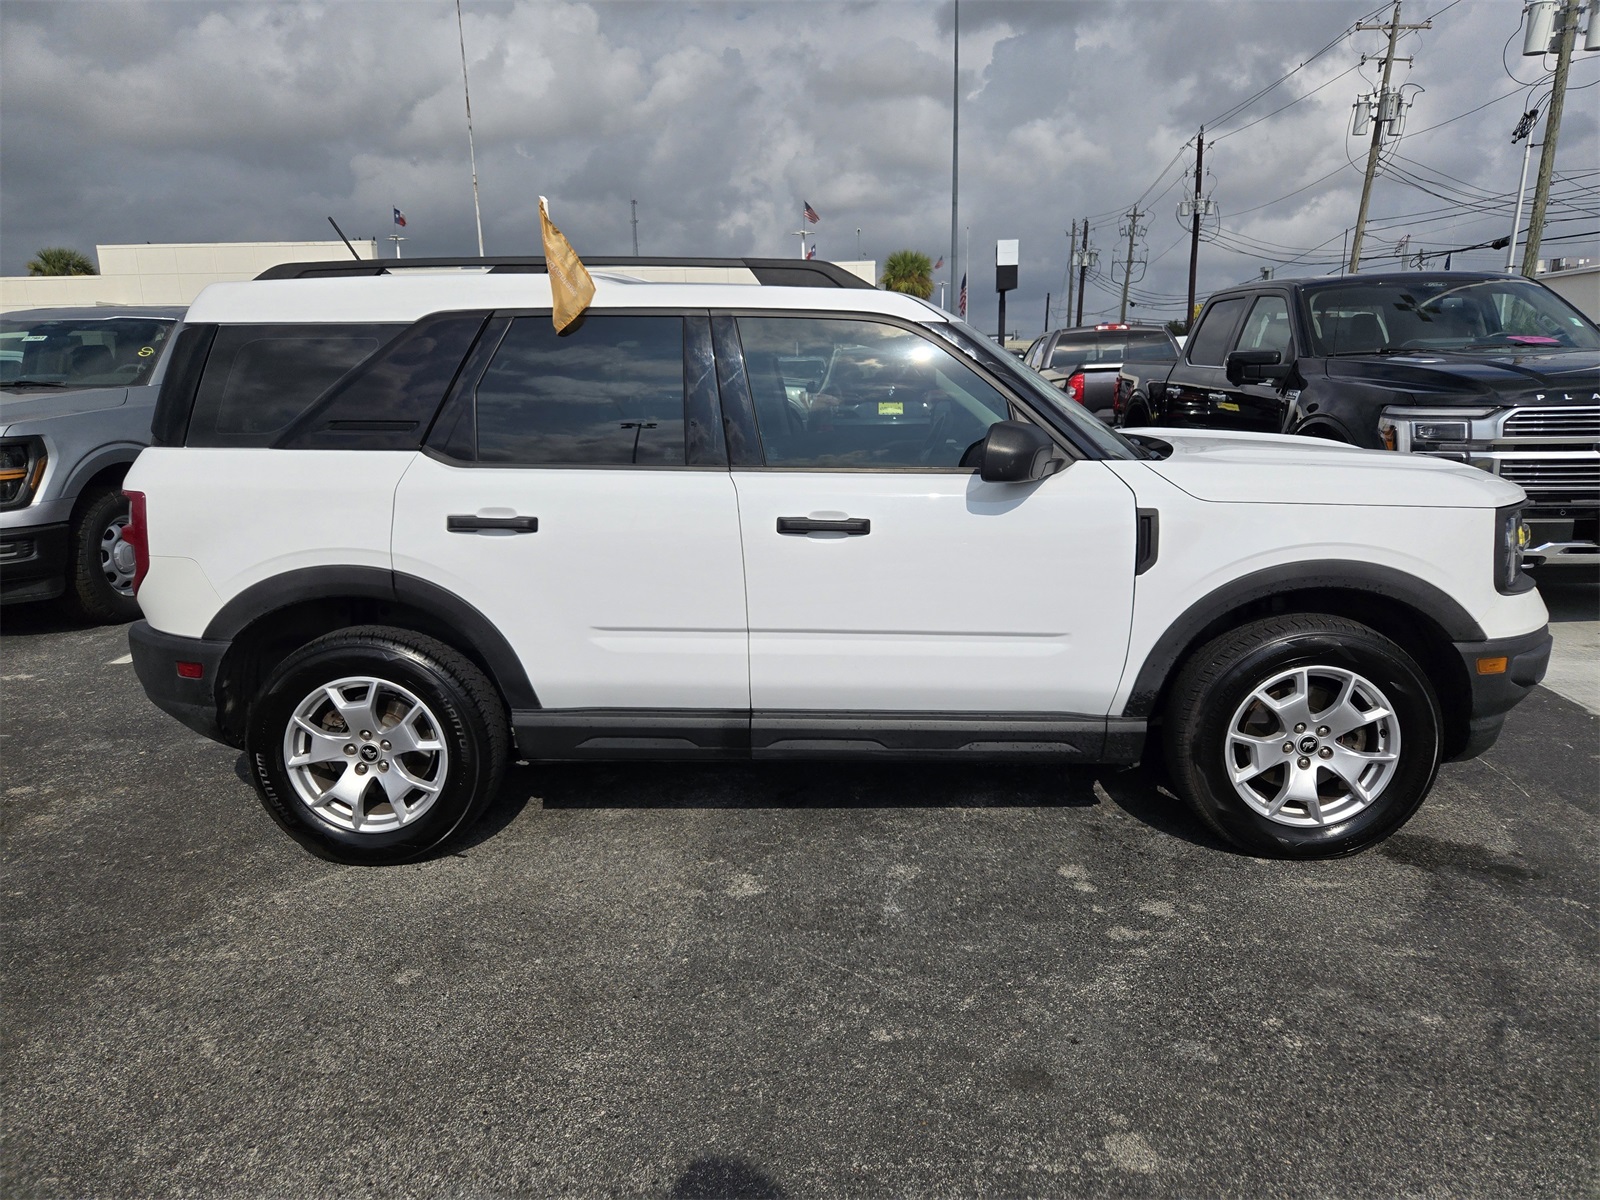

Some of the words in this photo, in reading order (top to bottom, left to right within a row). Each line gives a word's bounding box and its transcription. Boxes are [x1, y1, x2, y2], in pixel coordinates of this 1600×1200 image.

[1536, 393, 1600, 401] PLA
[437, 688, 471, 763] PHANTOM
[255, 752, 298, 827] PHANTOM
